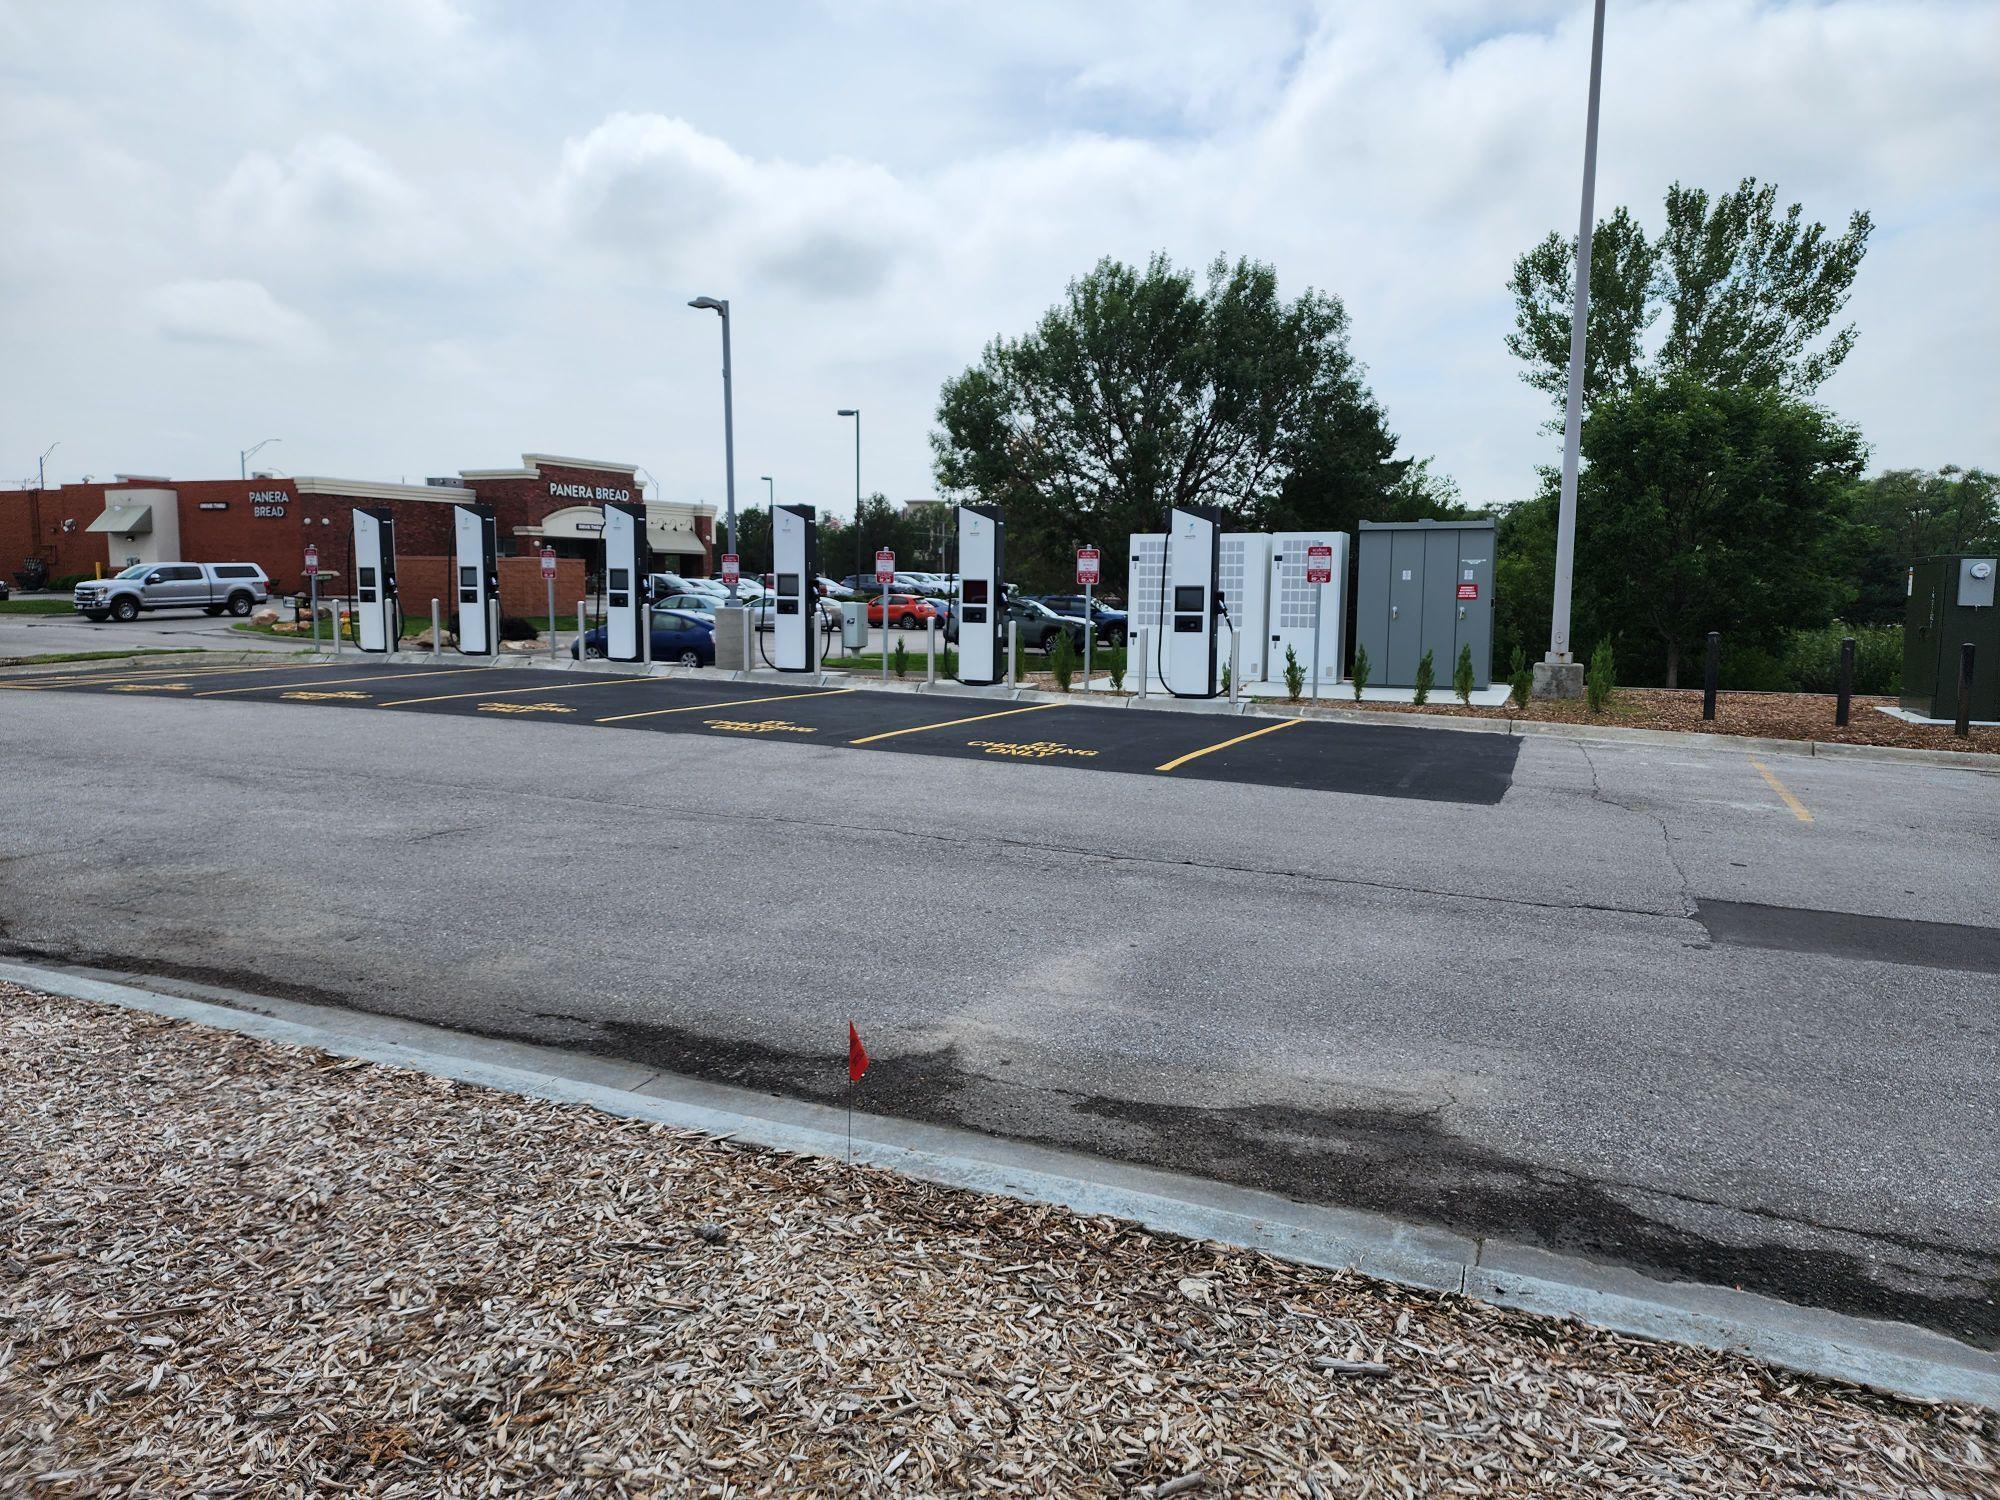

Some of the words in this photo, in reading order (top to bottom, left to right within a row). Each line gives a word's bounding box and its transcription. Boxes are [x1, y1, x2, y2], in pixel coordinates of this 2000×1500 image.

[249, 491, 289, 503] PANERA
[549, 482, 594, 499] PANERA
[595, 487, 630, 502] BREAD
[254, 506, 284, 517] BREAD
[967, 740, 1100, 756] CHARGING
[985, 747, 1056, 757] ONLY
